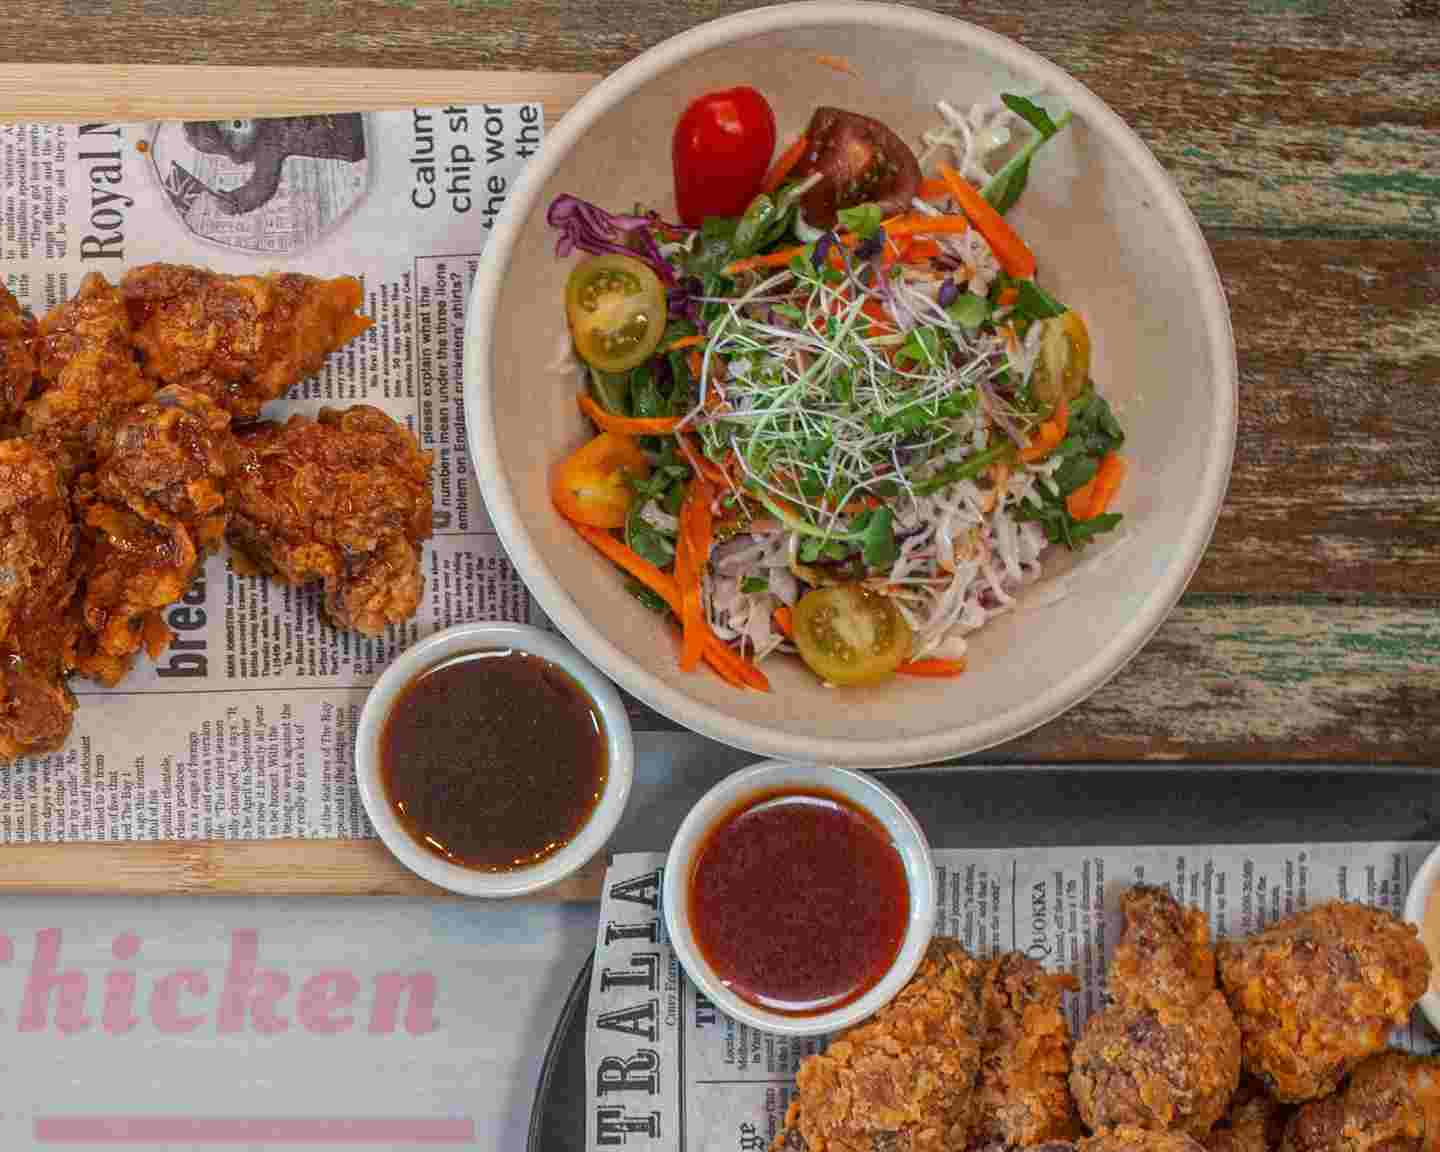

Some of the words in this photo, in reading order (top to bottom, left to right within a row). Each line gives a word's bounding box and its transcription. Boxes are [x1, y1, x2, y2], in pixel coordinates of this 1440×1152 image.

[483, 106, 505, 164] wor
[515, 105, 539, 159] the
[445, 144, 474, 214] chip
[78, 150, 134, 262] Royal
[483, 175, 506, 230] the
[417, 284, 431, 308] the
[434, 262, 447, 296] lions
[418, 312, 431, 344] what
[434, 300, 448, 334] three
[418, 348, 435, 396] explain
[435, 338, 448, 360] the
[435, 364, 449, 404] under
[419, 400, 436, 444] please
[439, 408, 449, 444] mean
[436, 448, 450, 506] numbers
[156, 564, 208, 678] brea
